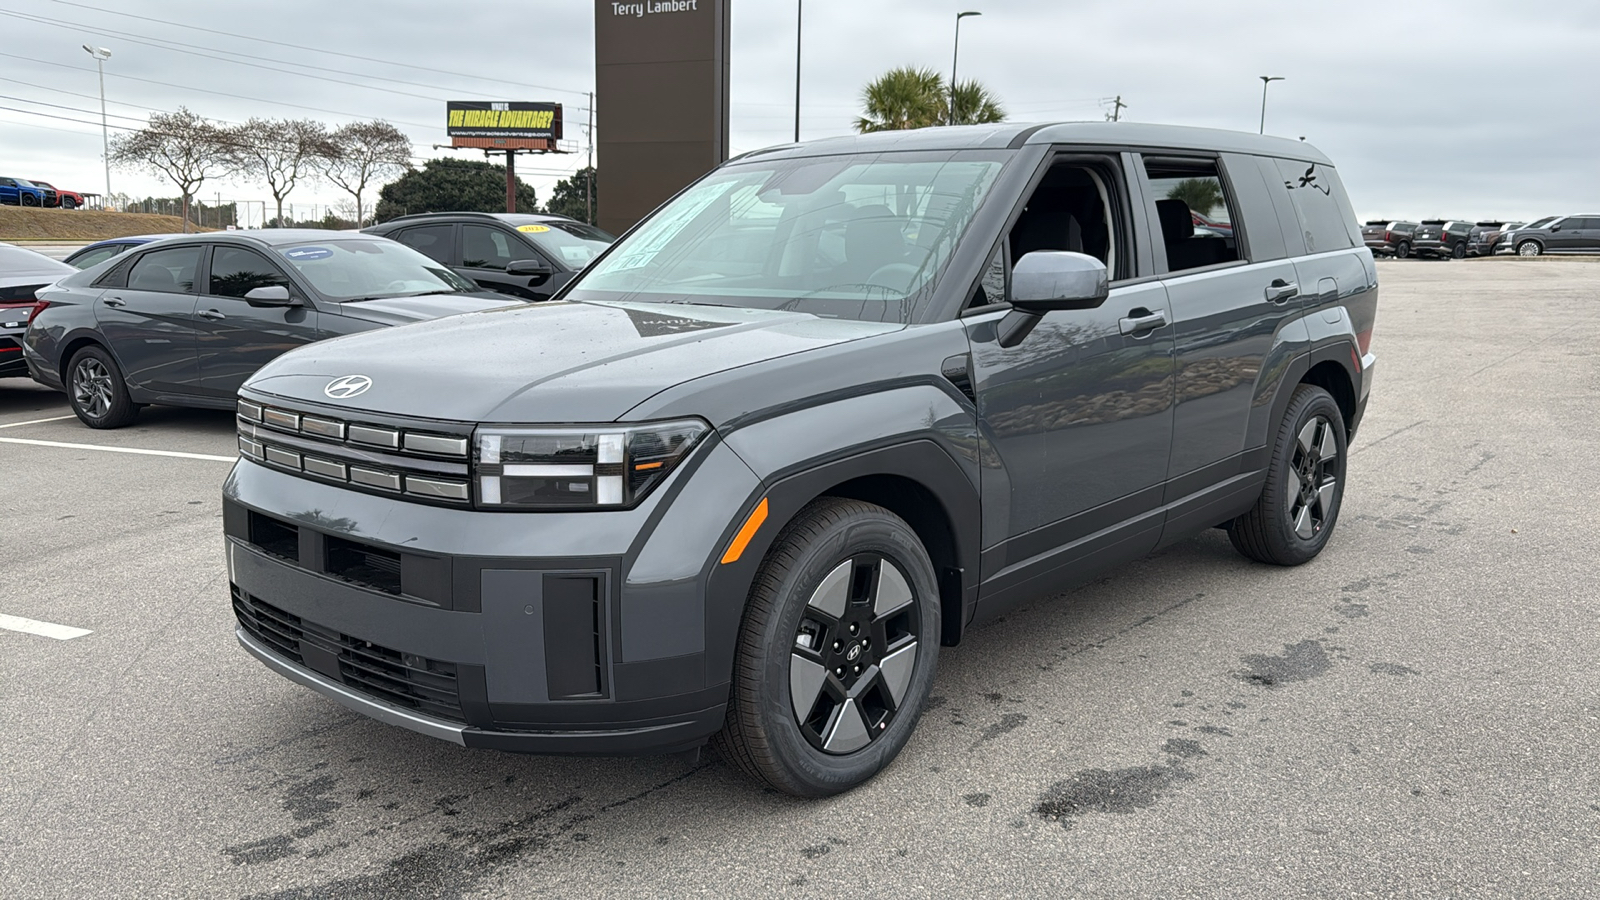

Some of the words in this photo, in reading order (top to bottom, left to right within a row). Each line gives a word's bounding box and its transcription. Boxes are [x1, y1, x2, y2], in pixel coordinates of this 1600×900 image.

[611, 2, 643, 18] Terry
[647, 0, 697, 13] Lambert
[491, 103, 503, 111] WHAT
[448, 110, 464, 127] THE
[463, 110, 500, 128] MIRACLE
[498, 110, 554, 129] ADVANTAGE?
